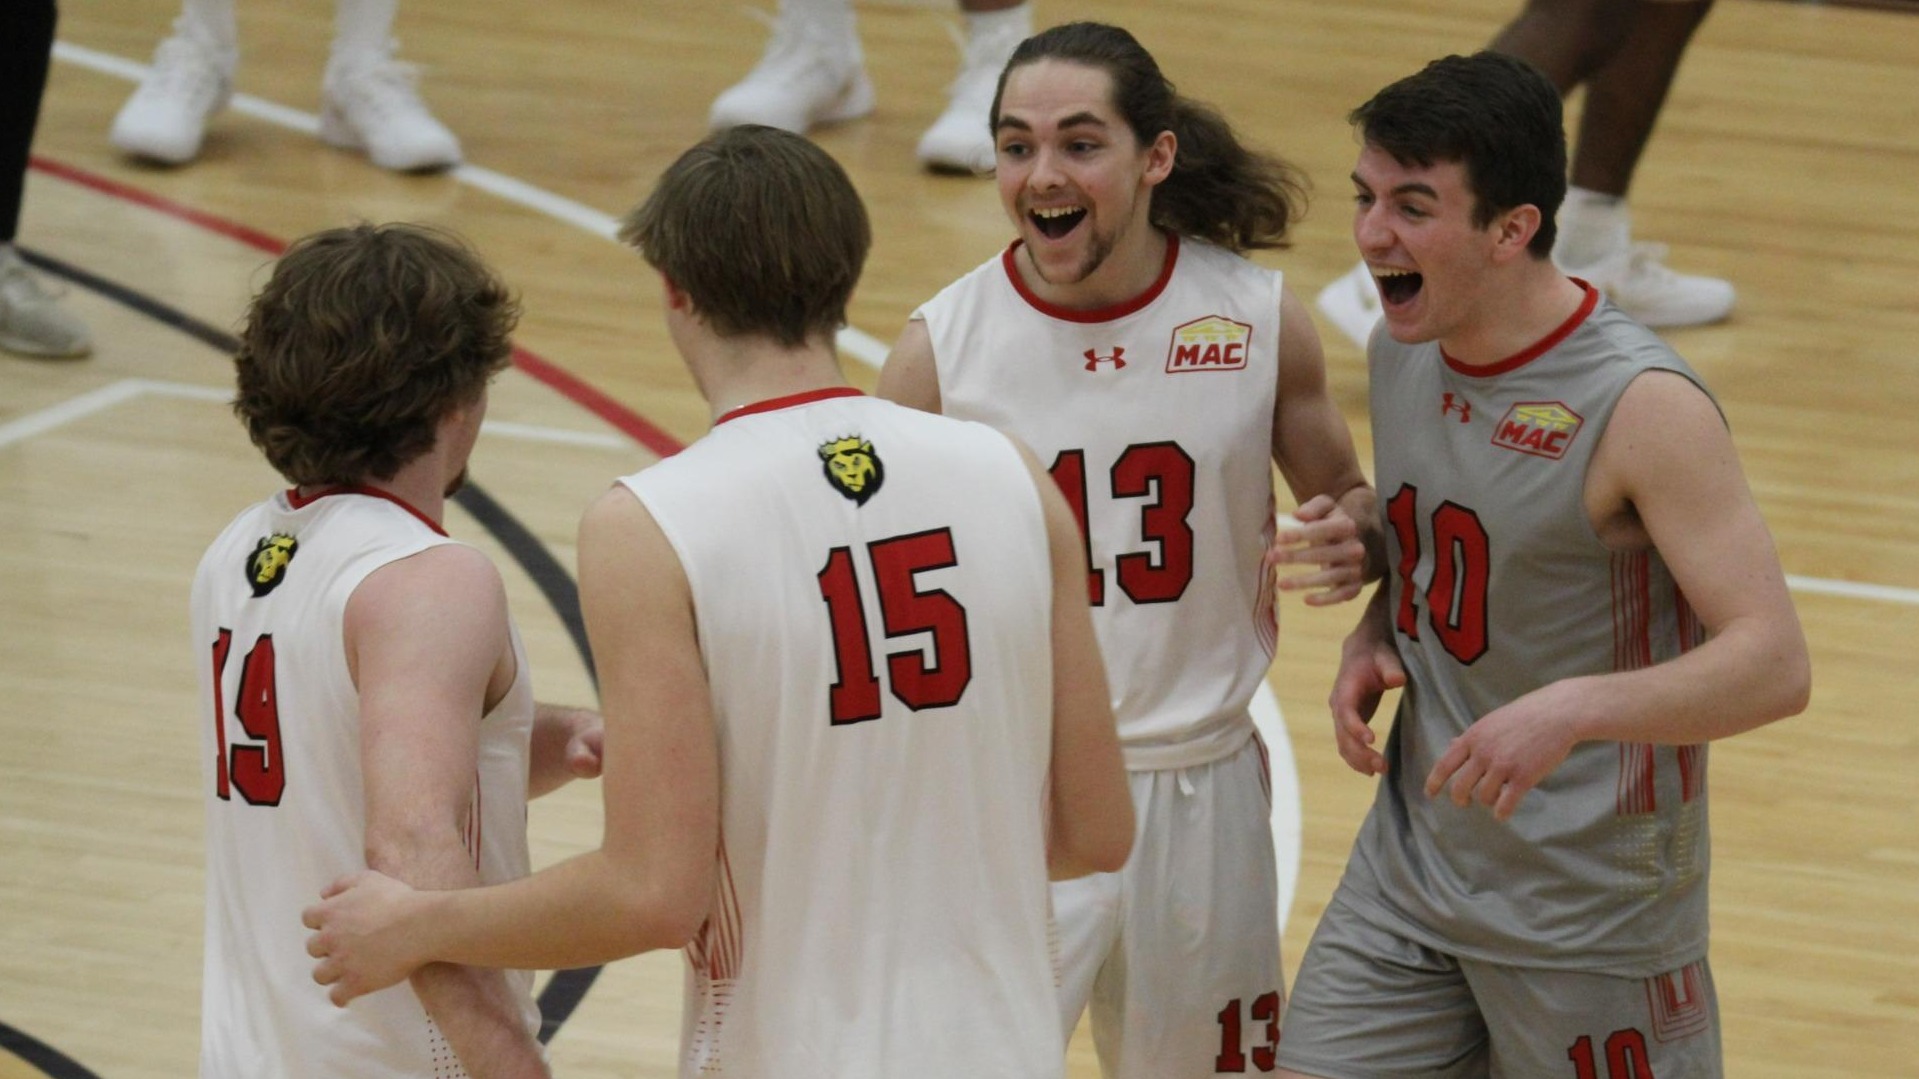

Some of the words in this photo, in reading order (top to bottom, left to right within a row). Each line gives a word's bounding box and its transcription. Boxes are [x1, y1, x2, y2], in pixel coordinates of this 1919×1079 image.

[1174, 343, 1243, 367] MAC
[1499, 420, 1569, 453] MAC
[817, 526, 972, 726] 15
[1386, 482, 1490, 666] 10
[212, 626, 286, 807] 19
[1215, 990, 1281, 1073] 13
